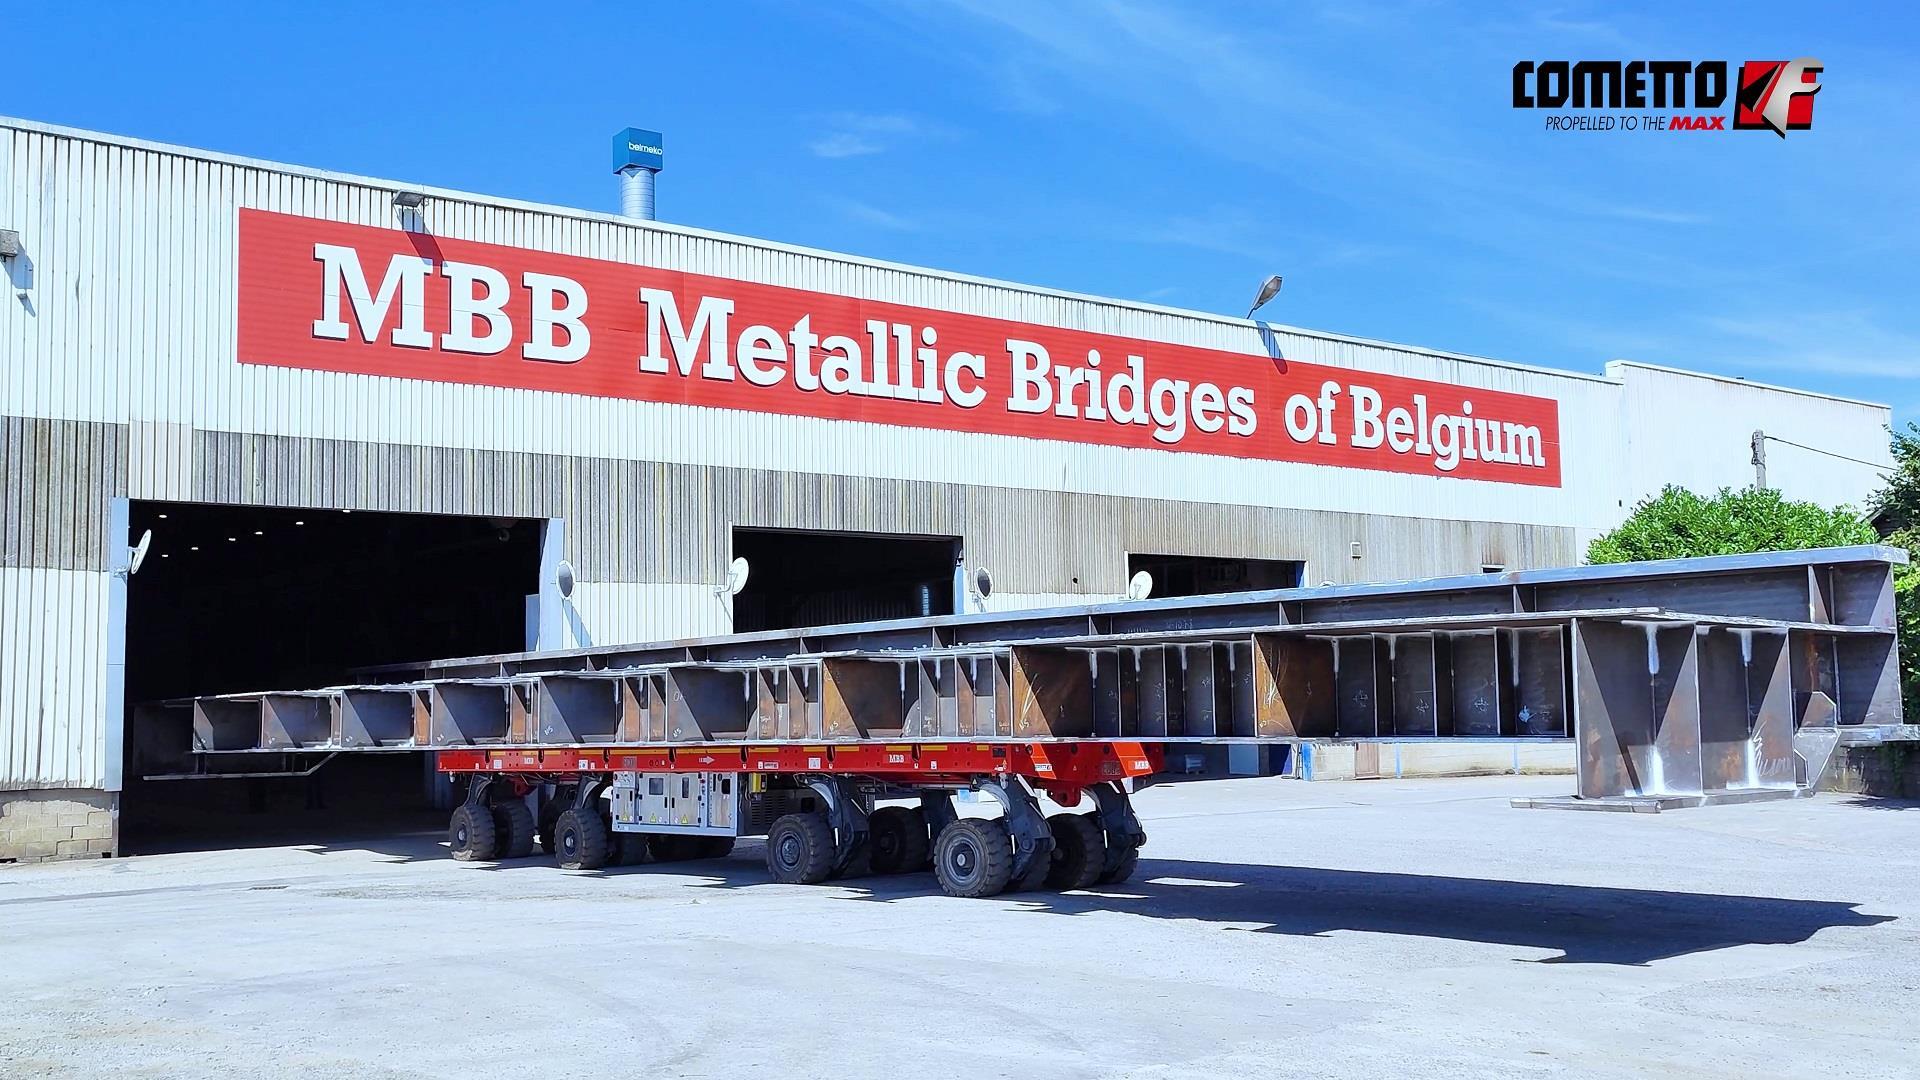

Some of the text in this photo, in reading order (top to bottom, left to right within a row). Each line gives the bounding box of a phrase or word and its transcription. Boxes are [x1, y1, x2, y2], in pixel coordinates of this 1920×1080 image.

[628, 141, 663, 155] belmeko
[312, 242, 1547, 471] MBB Metallic Bridges of Belgium
